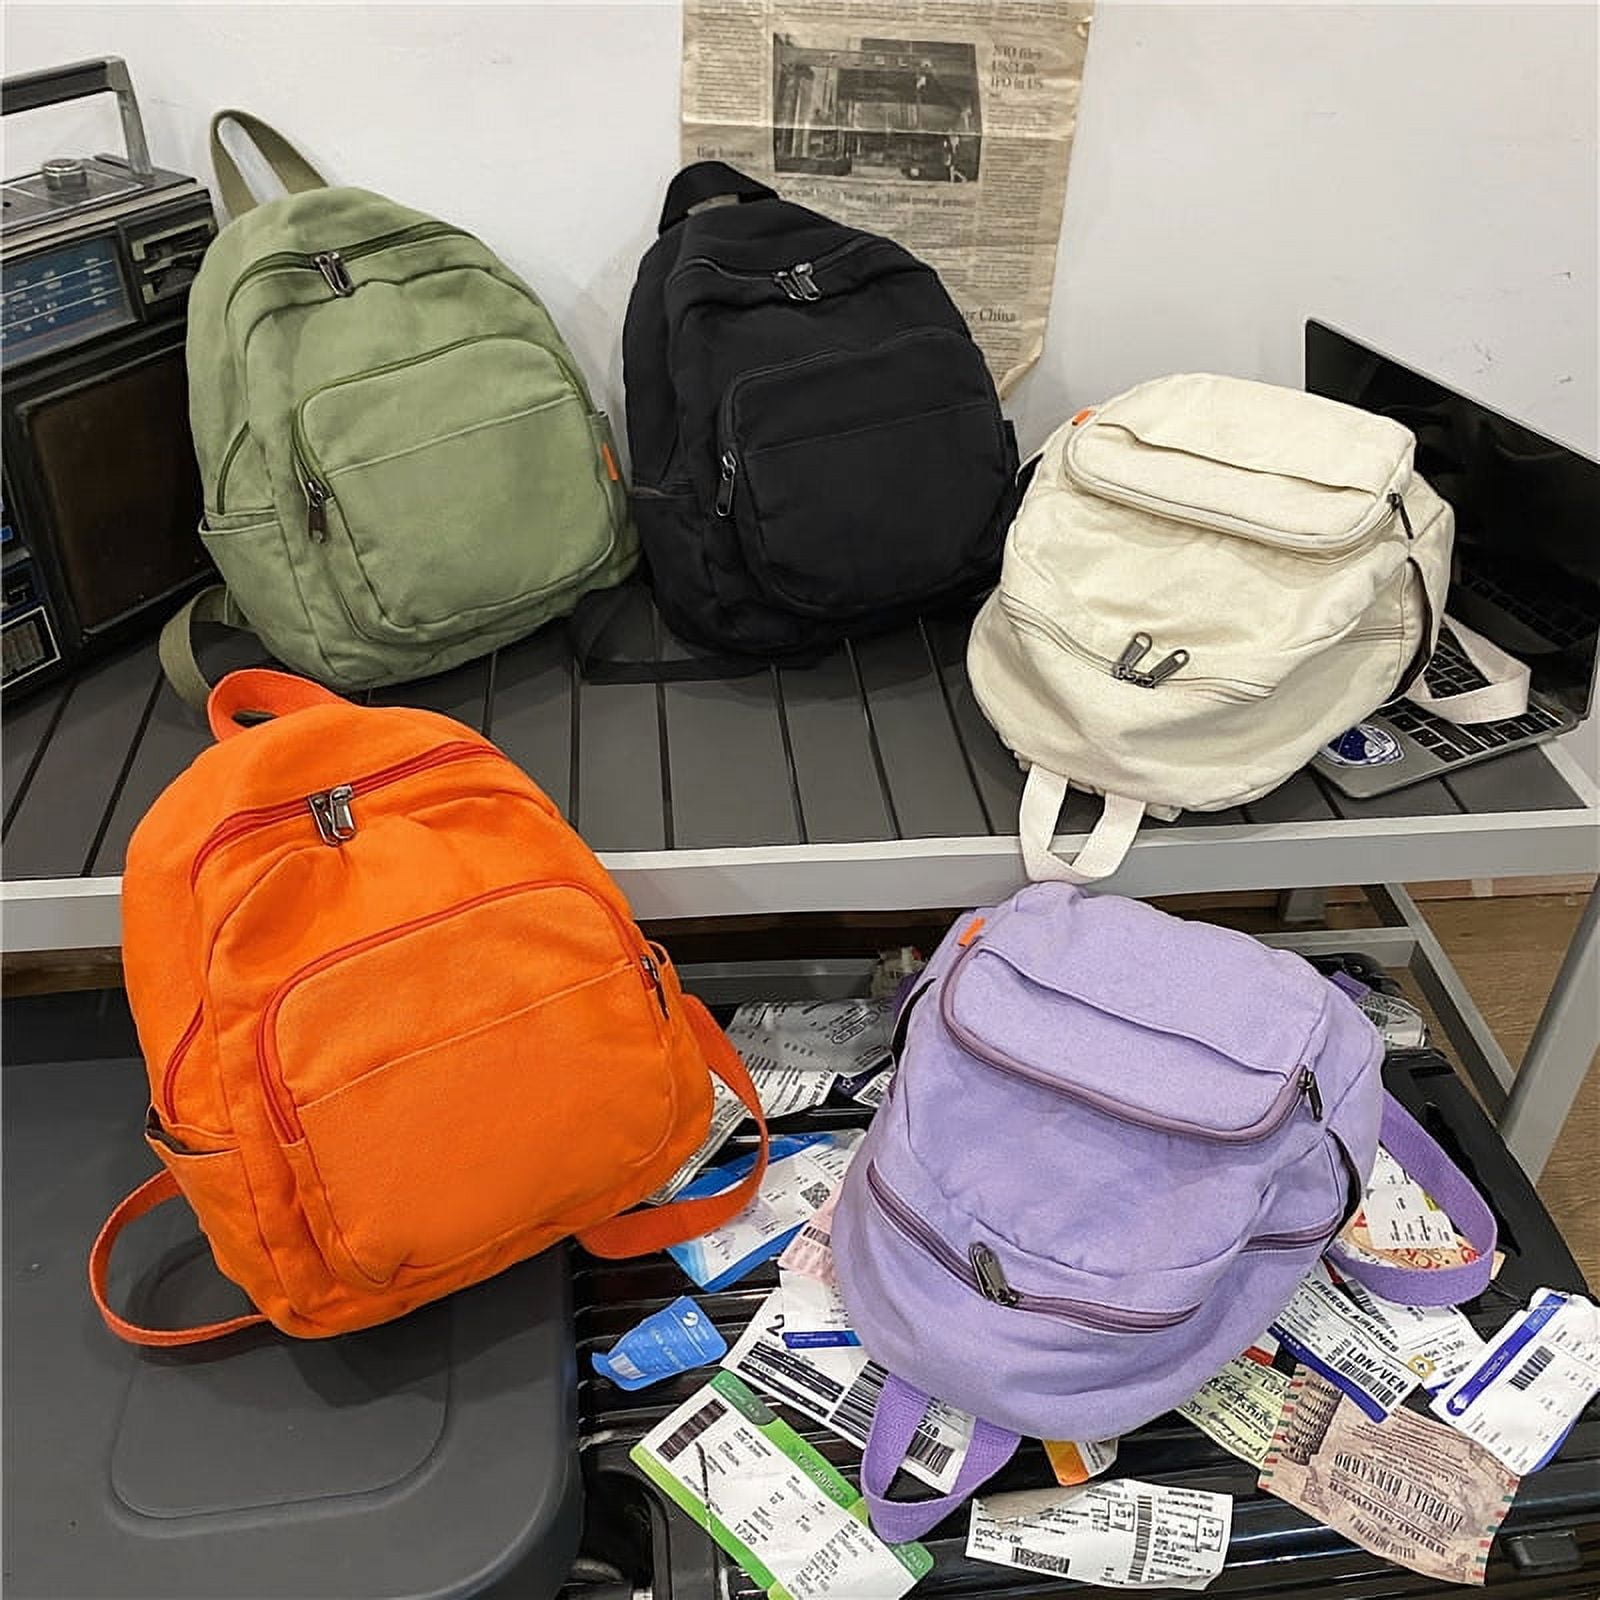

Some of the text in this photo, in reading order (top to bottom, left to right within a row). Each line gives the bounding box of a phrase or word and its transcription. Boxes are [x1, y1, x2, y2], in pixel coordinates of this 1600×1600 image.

[979, 306, 1017, 322] China
[766, 1314, 785, 1337] 2
[1350, 1314, 1400, 1353] AIRLINES
[1328, 1480, 1395, 1526] SHOWER
[1395, 1519, 1447, 1557] BRIDAL
